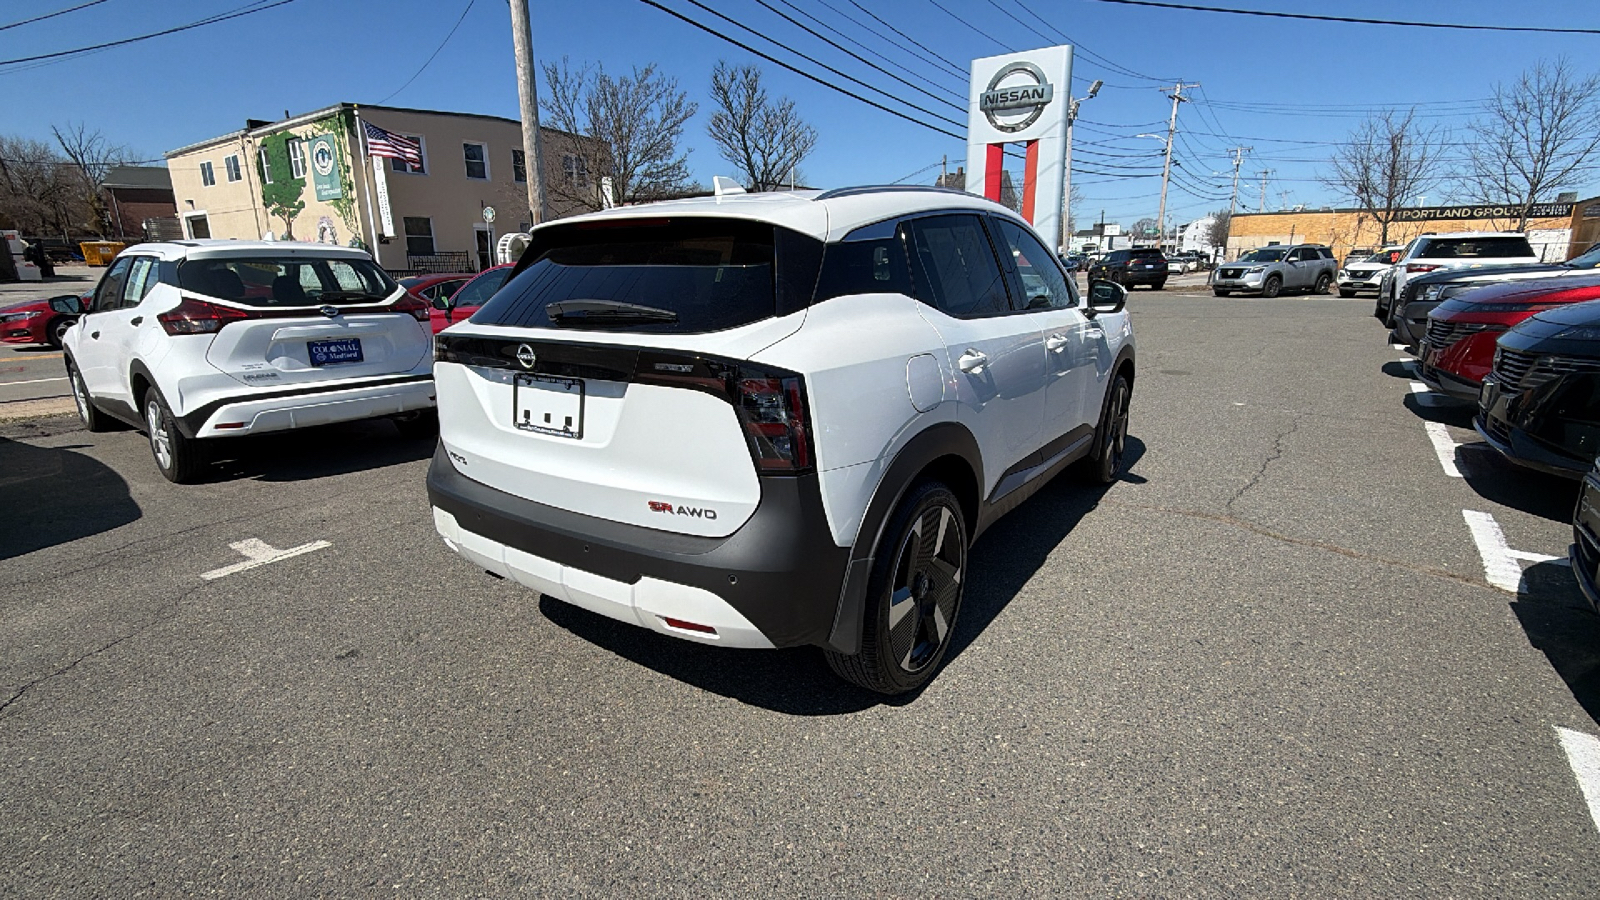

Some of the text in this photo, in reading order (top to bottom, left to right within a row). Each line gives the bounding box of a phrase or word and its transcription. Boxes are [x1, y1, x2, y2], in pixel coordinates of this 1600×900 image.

[984, 87, 1045, 106] NISSAN
[1402, 207, 1472, 219] PORTLAND
[312, 343, 359, 354] COLONIAL
[329, 351, 358, 360] Medford
[648, 500, 718, 520] SR AWD
